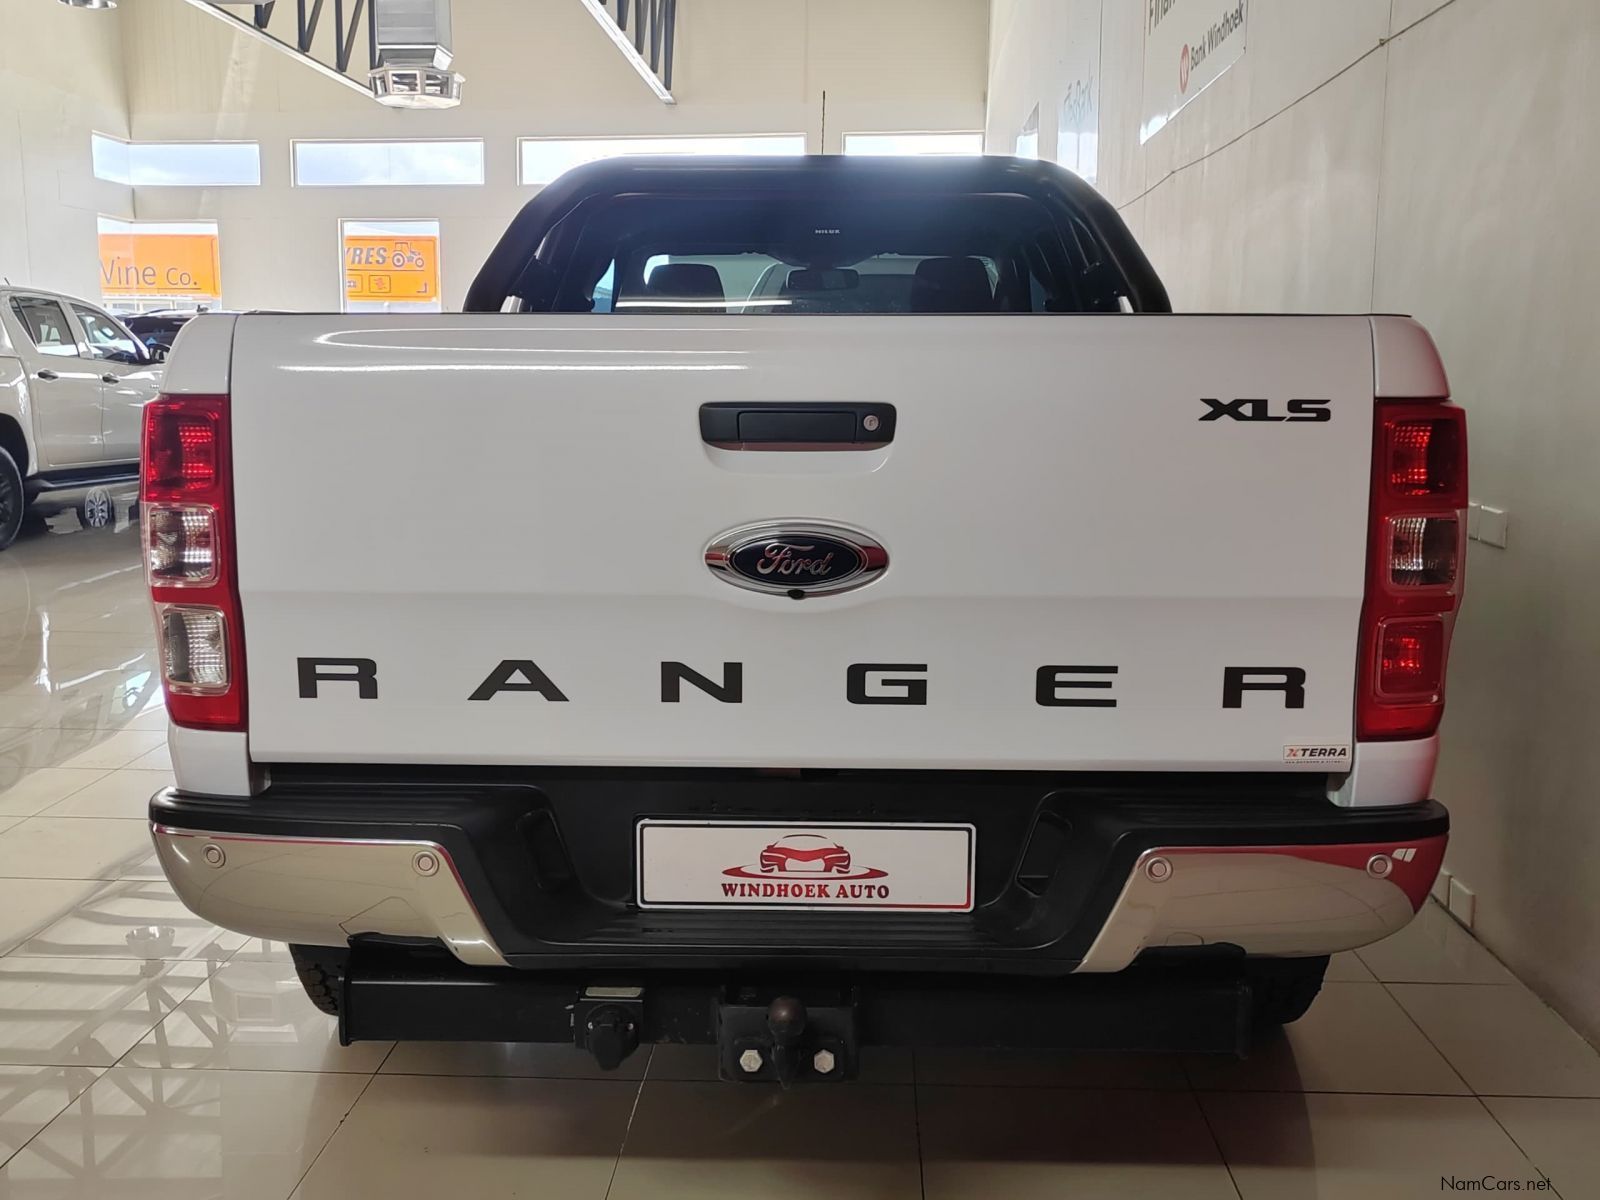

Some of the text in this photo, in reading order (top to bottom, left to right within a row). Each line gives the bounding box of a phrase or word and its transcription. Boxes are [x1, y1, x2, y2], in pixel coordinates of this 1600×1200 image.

[1190, 0, 1244, 71] Bank Windhoek
[166, 267, 198, 286] Co.
[1198, 398, 1332, 422] XLS
[756, 542, 835, 576] Ford
[297, 657, 1306, 709] RANGER
[721, 882, 890, 899] WINDHOEK AUTO
